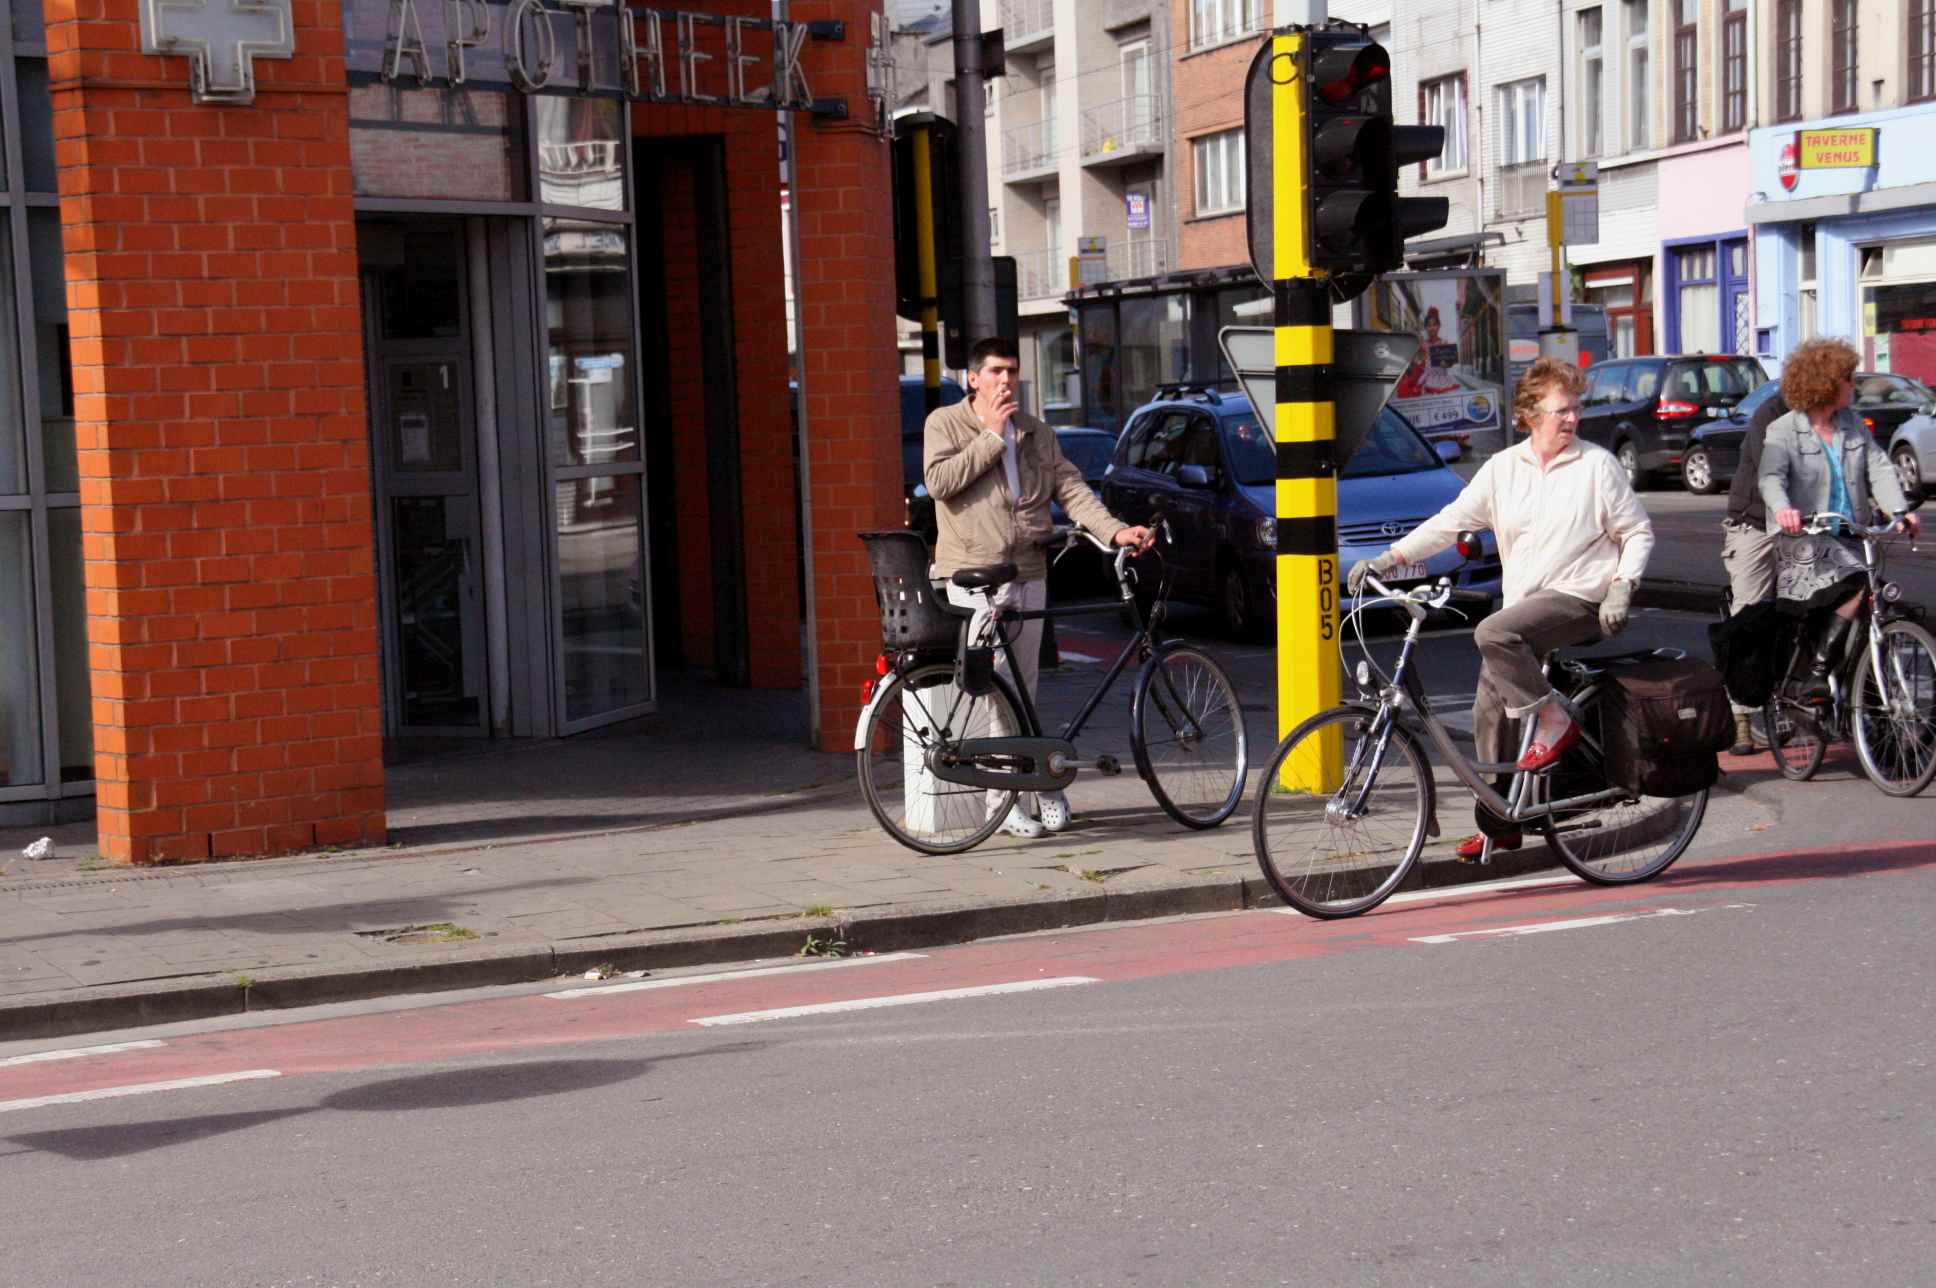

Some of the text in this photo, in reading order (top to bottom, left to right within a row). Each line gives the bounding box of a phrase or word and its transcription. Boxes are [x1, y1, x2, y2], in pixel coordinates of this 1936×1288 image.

[380, 0, 814, 108] APOTHEEK
[1806, 132, 1867, 147] TAVERNE
[1816, 151, 1861, 163] VENUS
